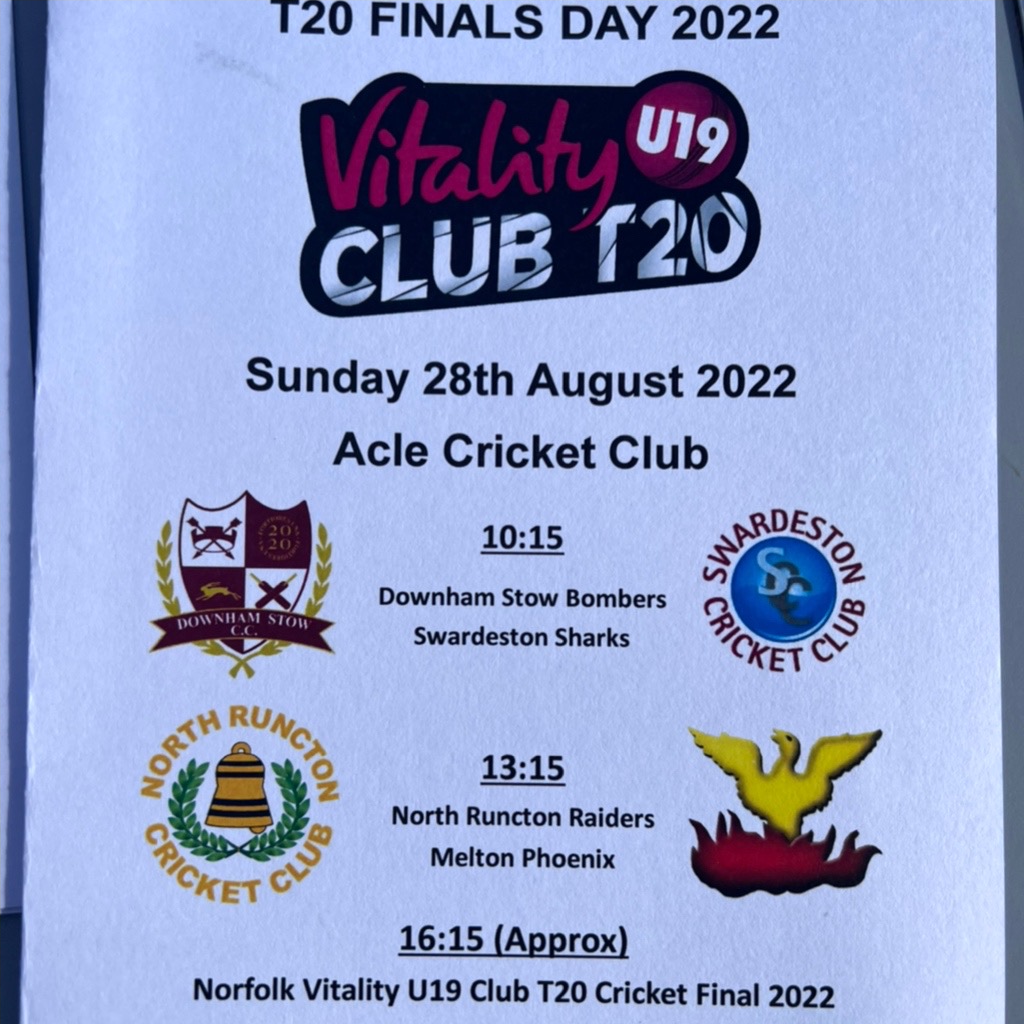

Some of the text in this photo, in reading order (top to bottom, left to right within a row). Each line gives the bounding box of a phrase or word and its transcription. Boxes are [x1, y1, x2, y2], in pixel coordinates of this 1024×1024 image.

[270, 0, 780, 41] T20 FINALS DAY 2022
[634, 103, 731, 166] U19
[318, 84, 621, 233] Vitality
[318, 190, 749, 308] CLUB T20
[245, 356, 797, 407] Sunday 28th August 2022
[332, 431, 709, 471] Acle Cricket Club
[482, 524, 564, 551] 10:15
[702, 508, 866, 585] SWARDESTON
[379, 585, 667, 609] Downham Stow Bombers
[177, 612, 312, 630] DOWNHAM STOW
[230, 625, 258, 636] C.C.
[413, 625, 630, 648] Swardeston Sharks
[703, 596, 866, 673] CRICKET CLUB
[140, 704, 340, 803] NORTH RUNCTON
[482, 753, 565, 782] 13:15
[392, 804, 655, 829] North Runcton Raiders
[144, 822, 333, 904] CRICKET CLUB
[430, 845, 616, 870] Melton Phoenix
[400, 923, 629, 960] 16:15 (Approx)
[193, 976, 836, 1009] Norfolk Vitality U19 Club T20 Cricket Final 2022
